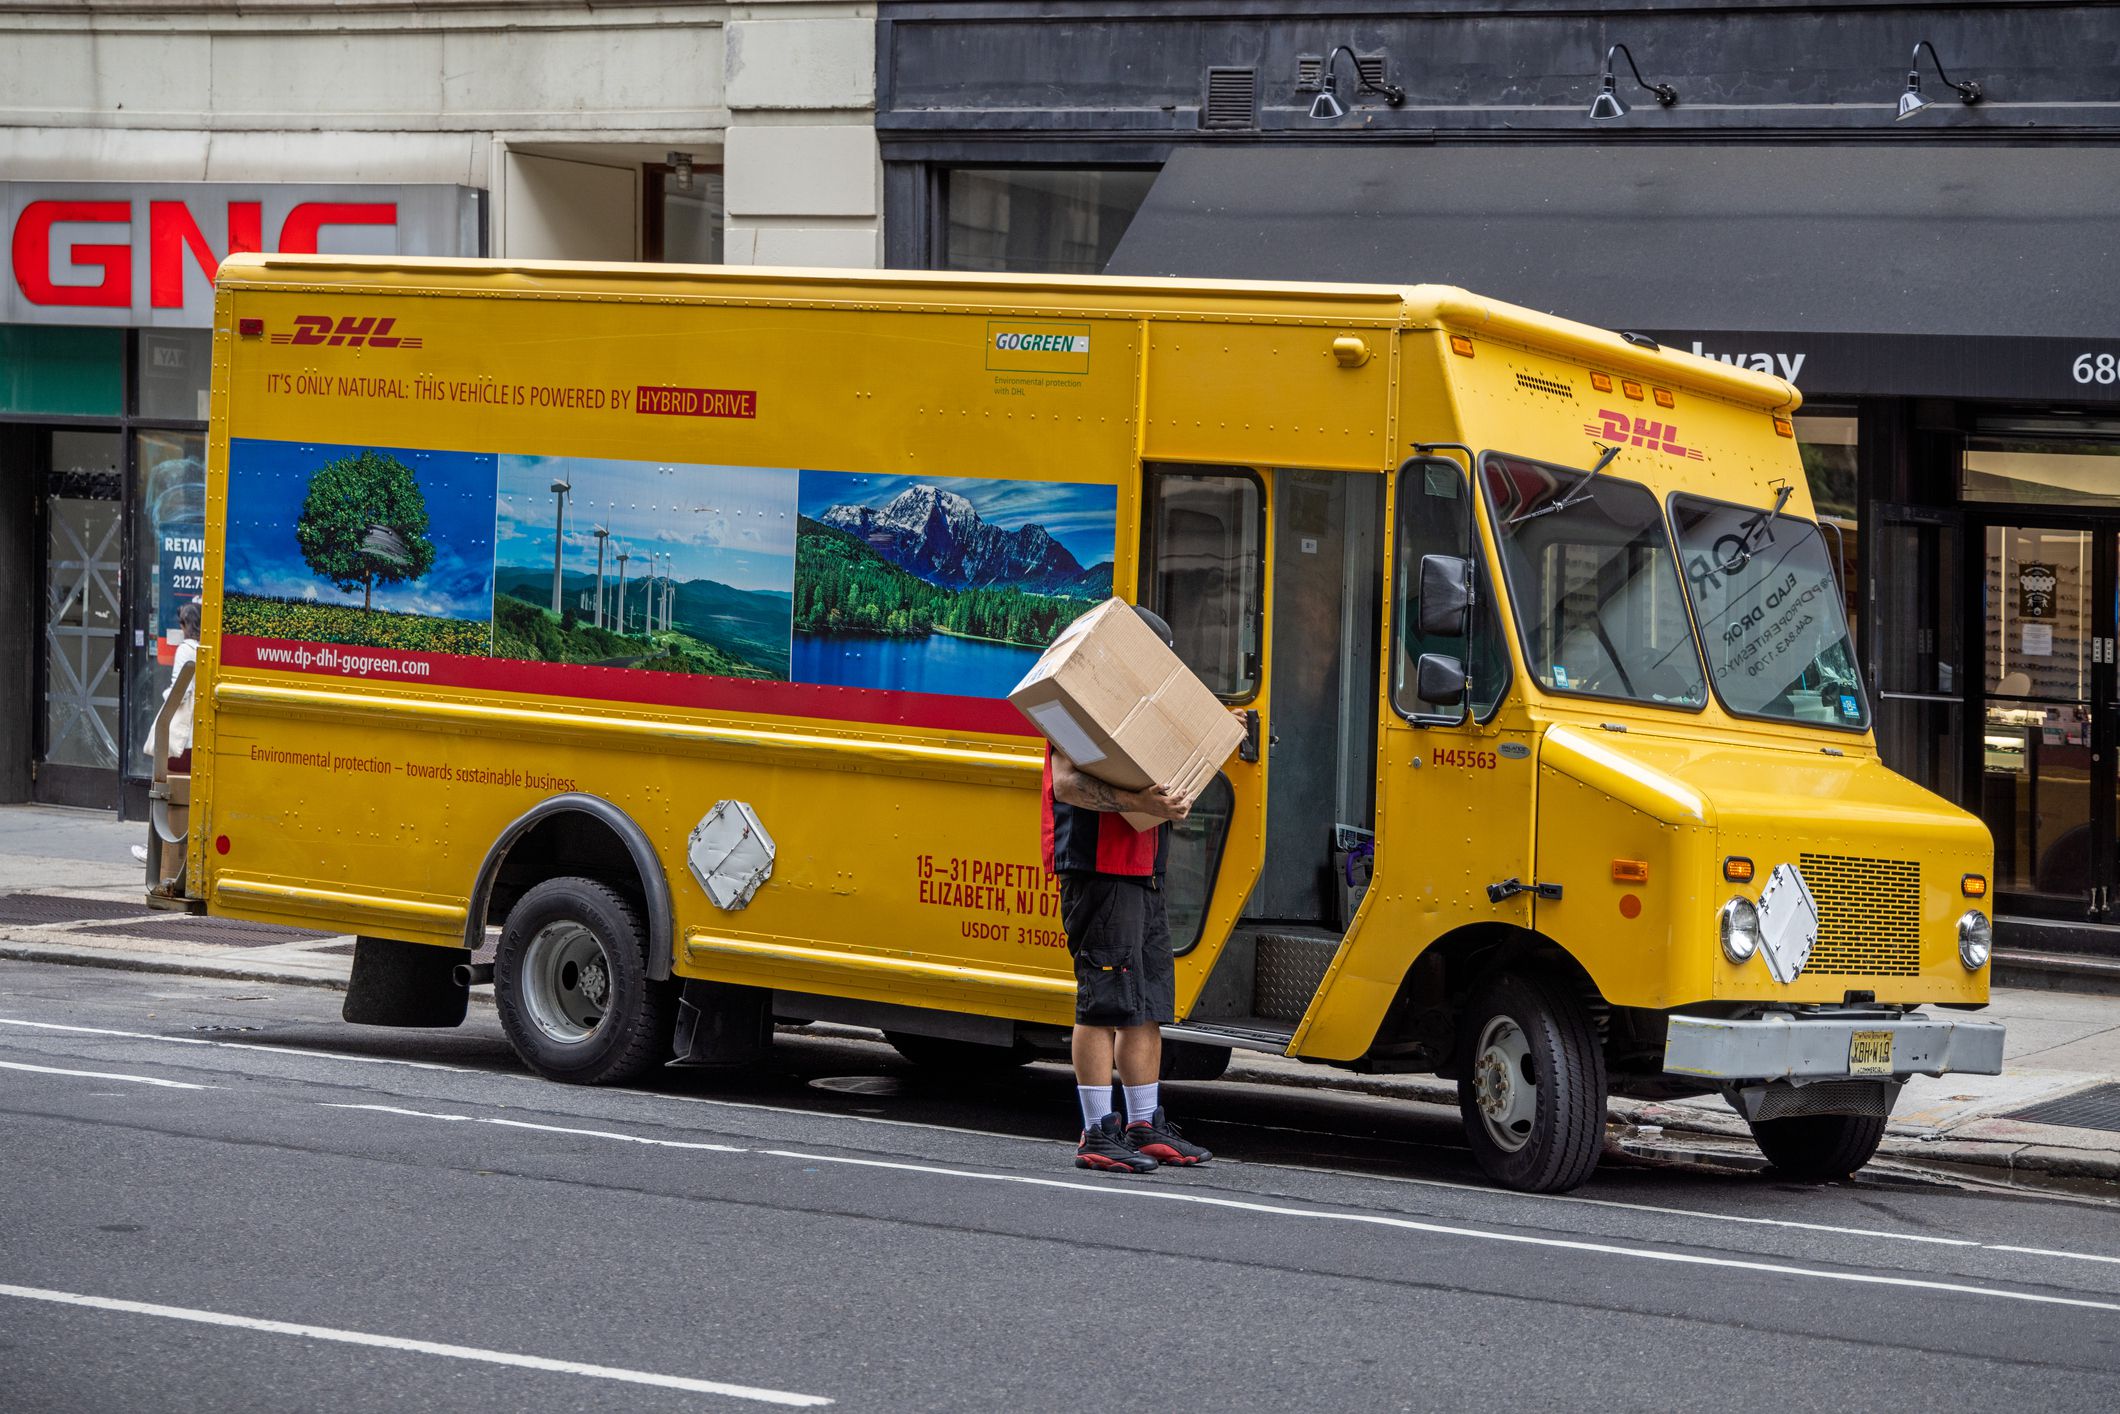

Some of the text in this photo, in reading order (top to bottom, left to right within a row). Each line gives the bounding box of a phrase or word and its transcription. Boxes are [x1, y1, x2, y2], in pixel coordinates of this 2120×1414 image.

[290, 315, 402, 348] DHL
[996, 333, 1074, 352] GOGREEN
[994, 376, 1081, 389] Environmental protection
[2073, 353, 2120, 384] 68
[267, 374, 754, 416] IT'S ONLY NATURAL: THIS VEHICLE IS POWERED BY HYBRID DRIVE.
[993, 387, 1025, 397] with DHL
[1598, 408, 1687, 458] DHL
[257, 646, 430, 676] www.dp-dhl-gogreen.com
[251, 744, 331, 768] Environmental
[333, 755, 392, 774] protection
[406, 761, 453, 781] towards
[456, 767, 522, 788] sustainable
[524, 770, 579, 792] business.
[1433, 747, 1497, 770] H45563
[972, 860, 1040, 891] PAPETTI
[919, 880, 1010, 916] ELIZABETH,
[1016, 889, 1034, 915] NJ
[961, 920, 1067, 949] USDOT 315026
